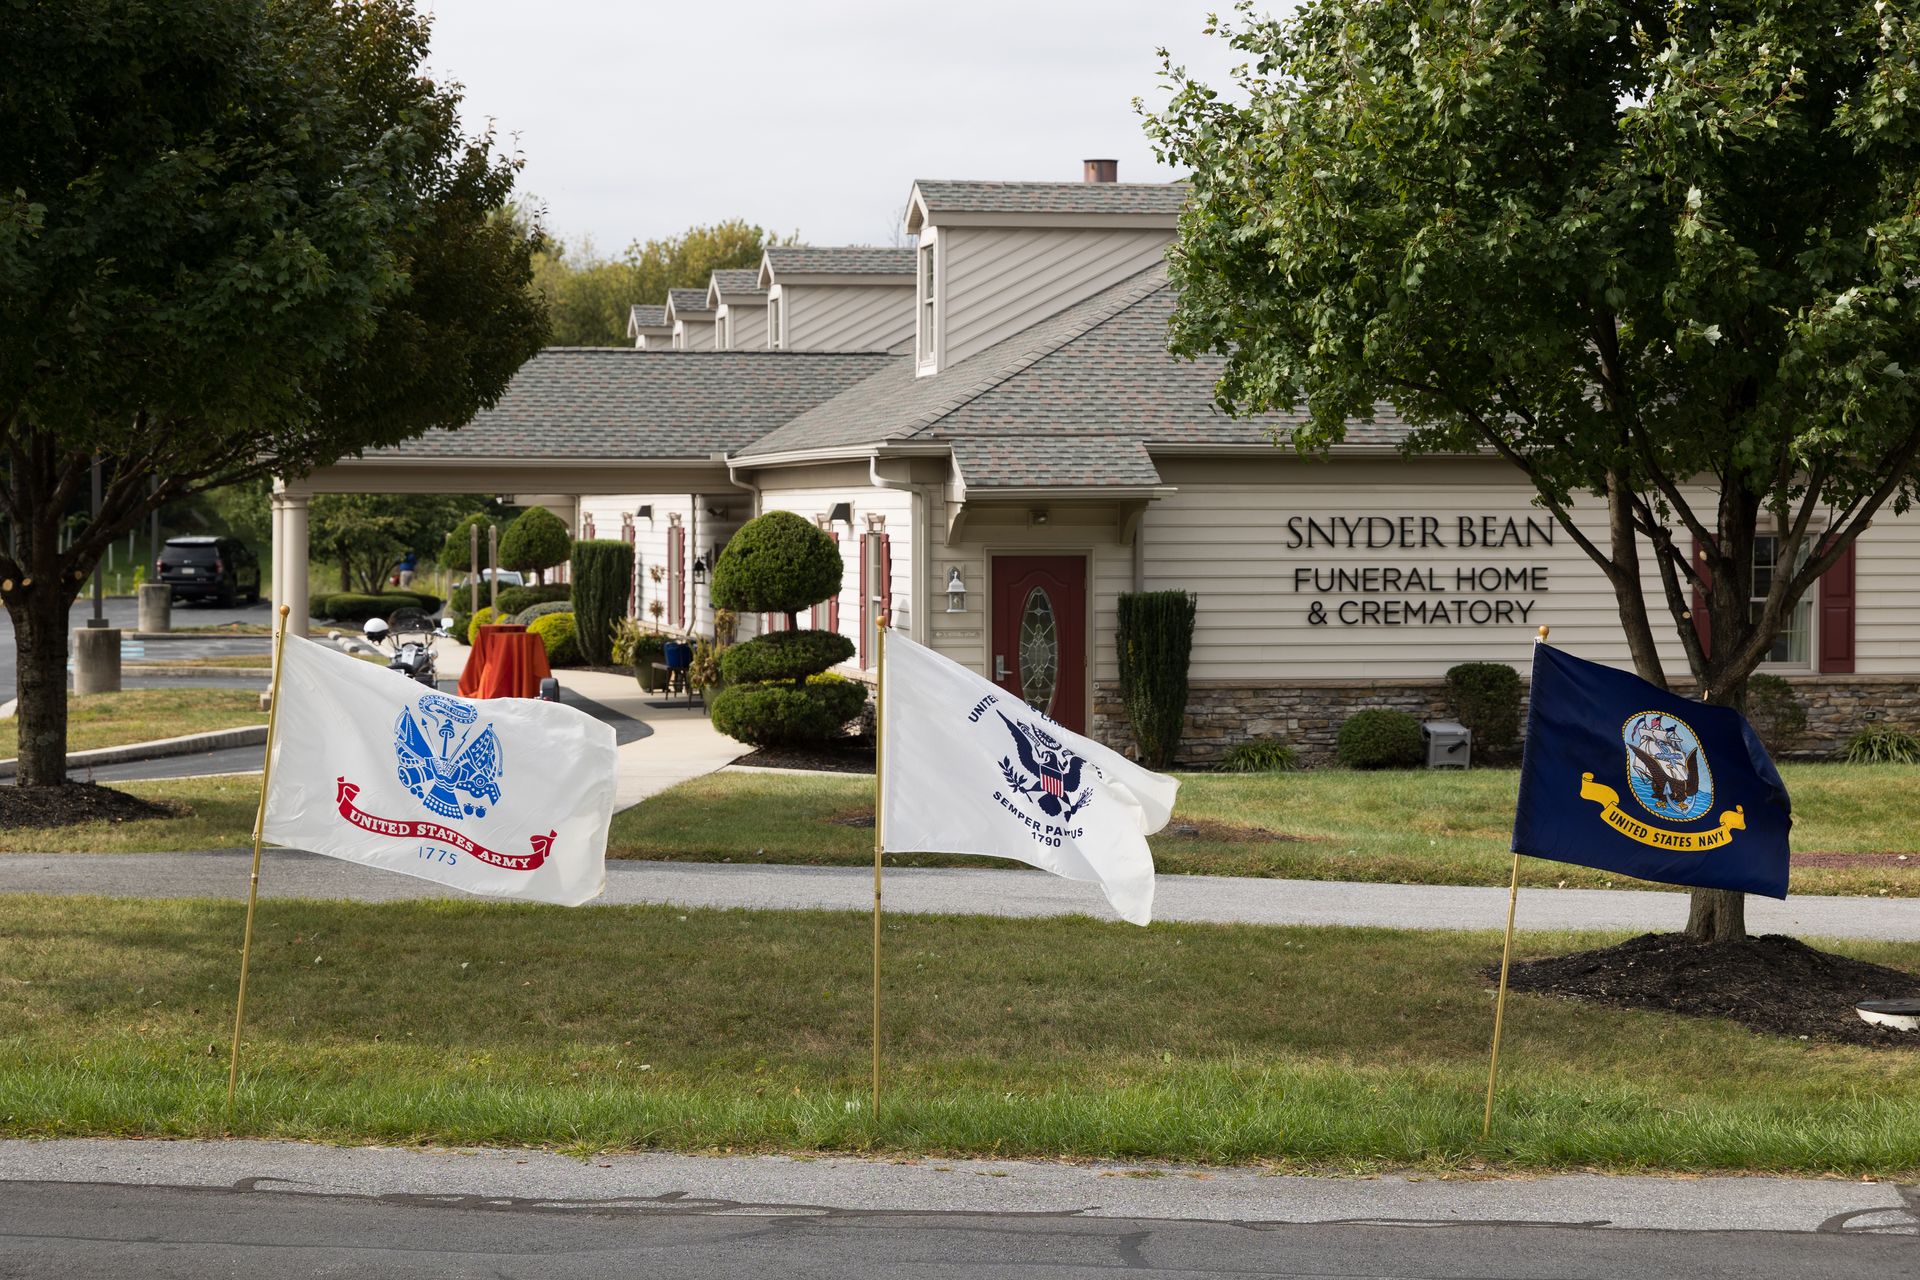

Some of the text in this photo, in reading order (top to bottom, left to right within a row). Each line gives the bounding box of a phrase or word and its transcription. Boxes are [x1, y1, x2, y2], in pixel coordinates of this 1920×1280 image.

[1286, 516, 1554, 549] SNYDER BEAN
[1294, 567, 1549, 592] FUNERAL HOME
[1307, 600, 1535, 625] & CREMATORY
[967, 693, 999, 723] UNITE
[992, 791, 1041, 831] SEMPER
[350, 811, 531, 869] UNITED STATES ARMY
[1031, 832, 1061, 847] 1790
[1609, 811, 1725, 847] UNITED STATES NAVY
[418, 846, 457, 866] 1775
